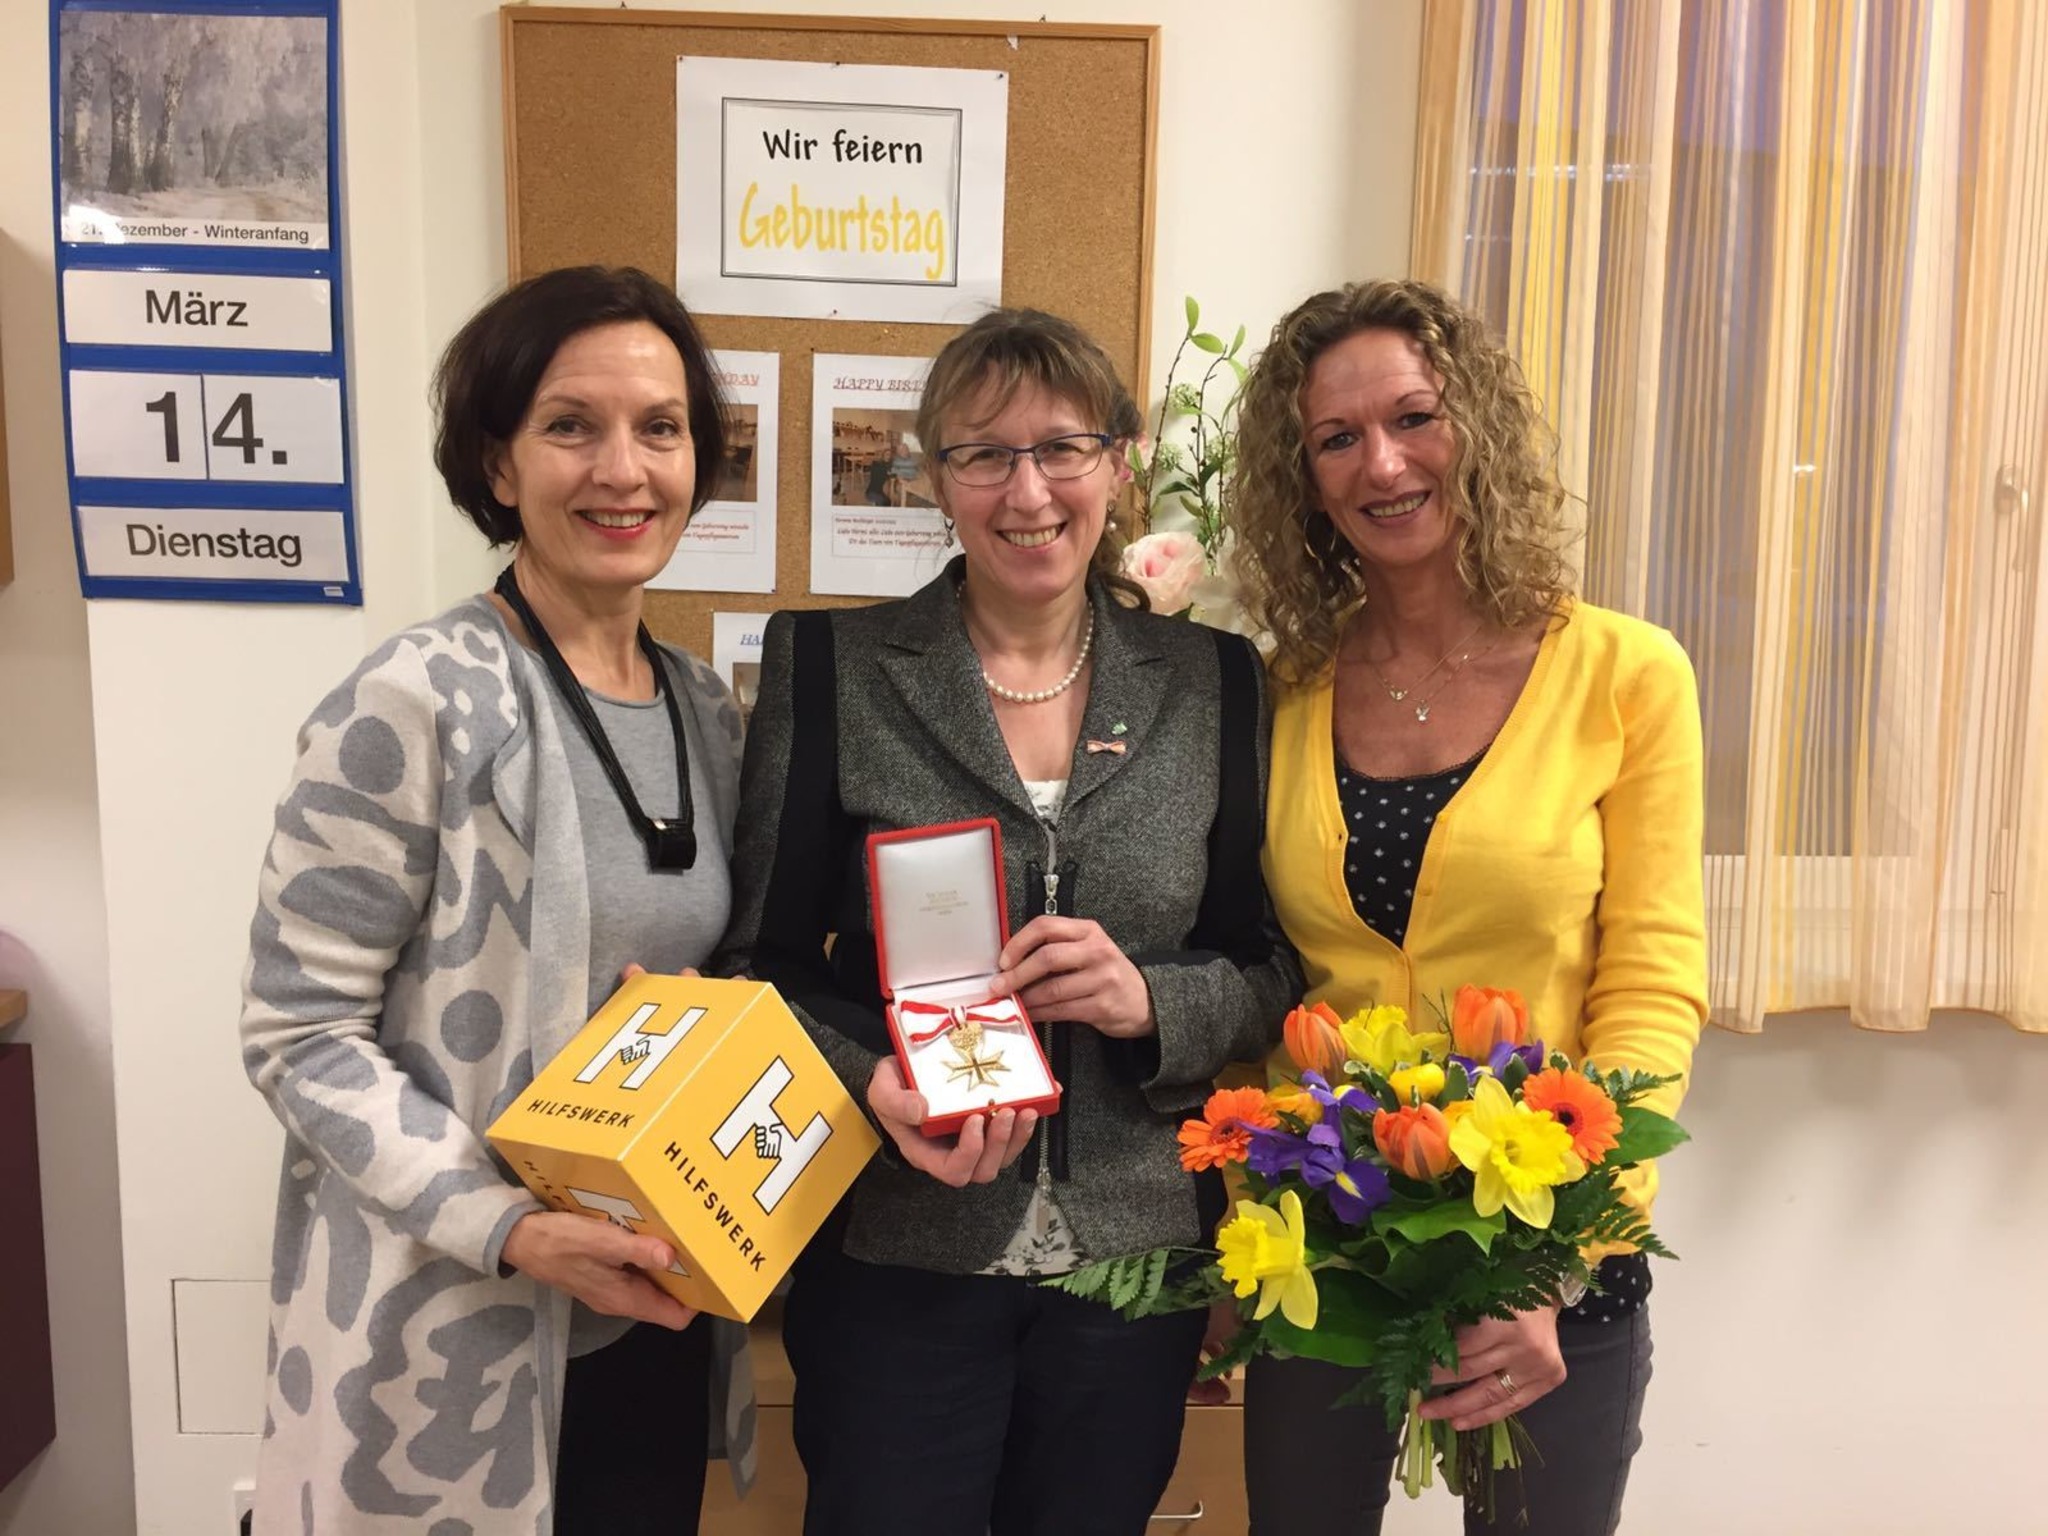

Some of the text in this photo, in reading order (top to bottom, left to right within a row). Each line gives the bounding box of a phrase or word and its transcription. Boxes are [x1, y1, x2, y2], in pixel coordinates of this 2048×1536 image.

[762, 128, 923, 164] Wir feiern
[105, 222, 188, 238] ezember
[204, 225, 310, 244] Winteranfang
[738, 181, 945, 282] Geburtstag
[145, 289, 249, 328] März
[833, 375, 884, 390] HAPPY
[126, 523, 302, 568] Dienstag
[527, 1099, 636, 1128] HILFSWERK
[664, 1140, 767, 1272] HILFSWERK
